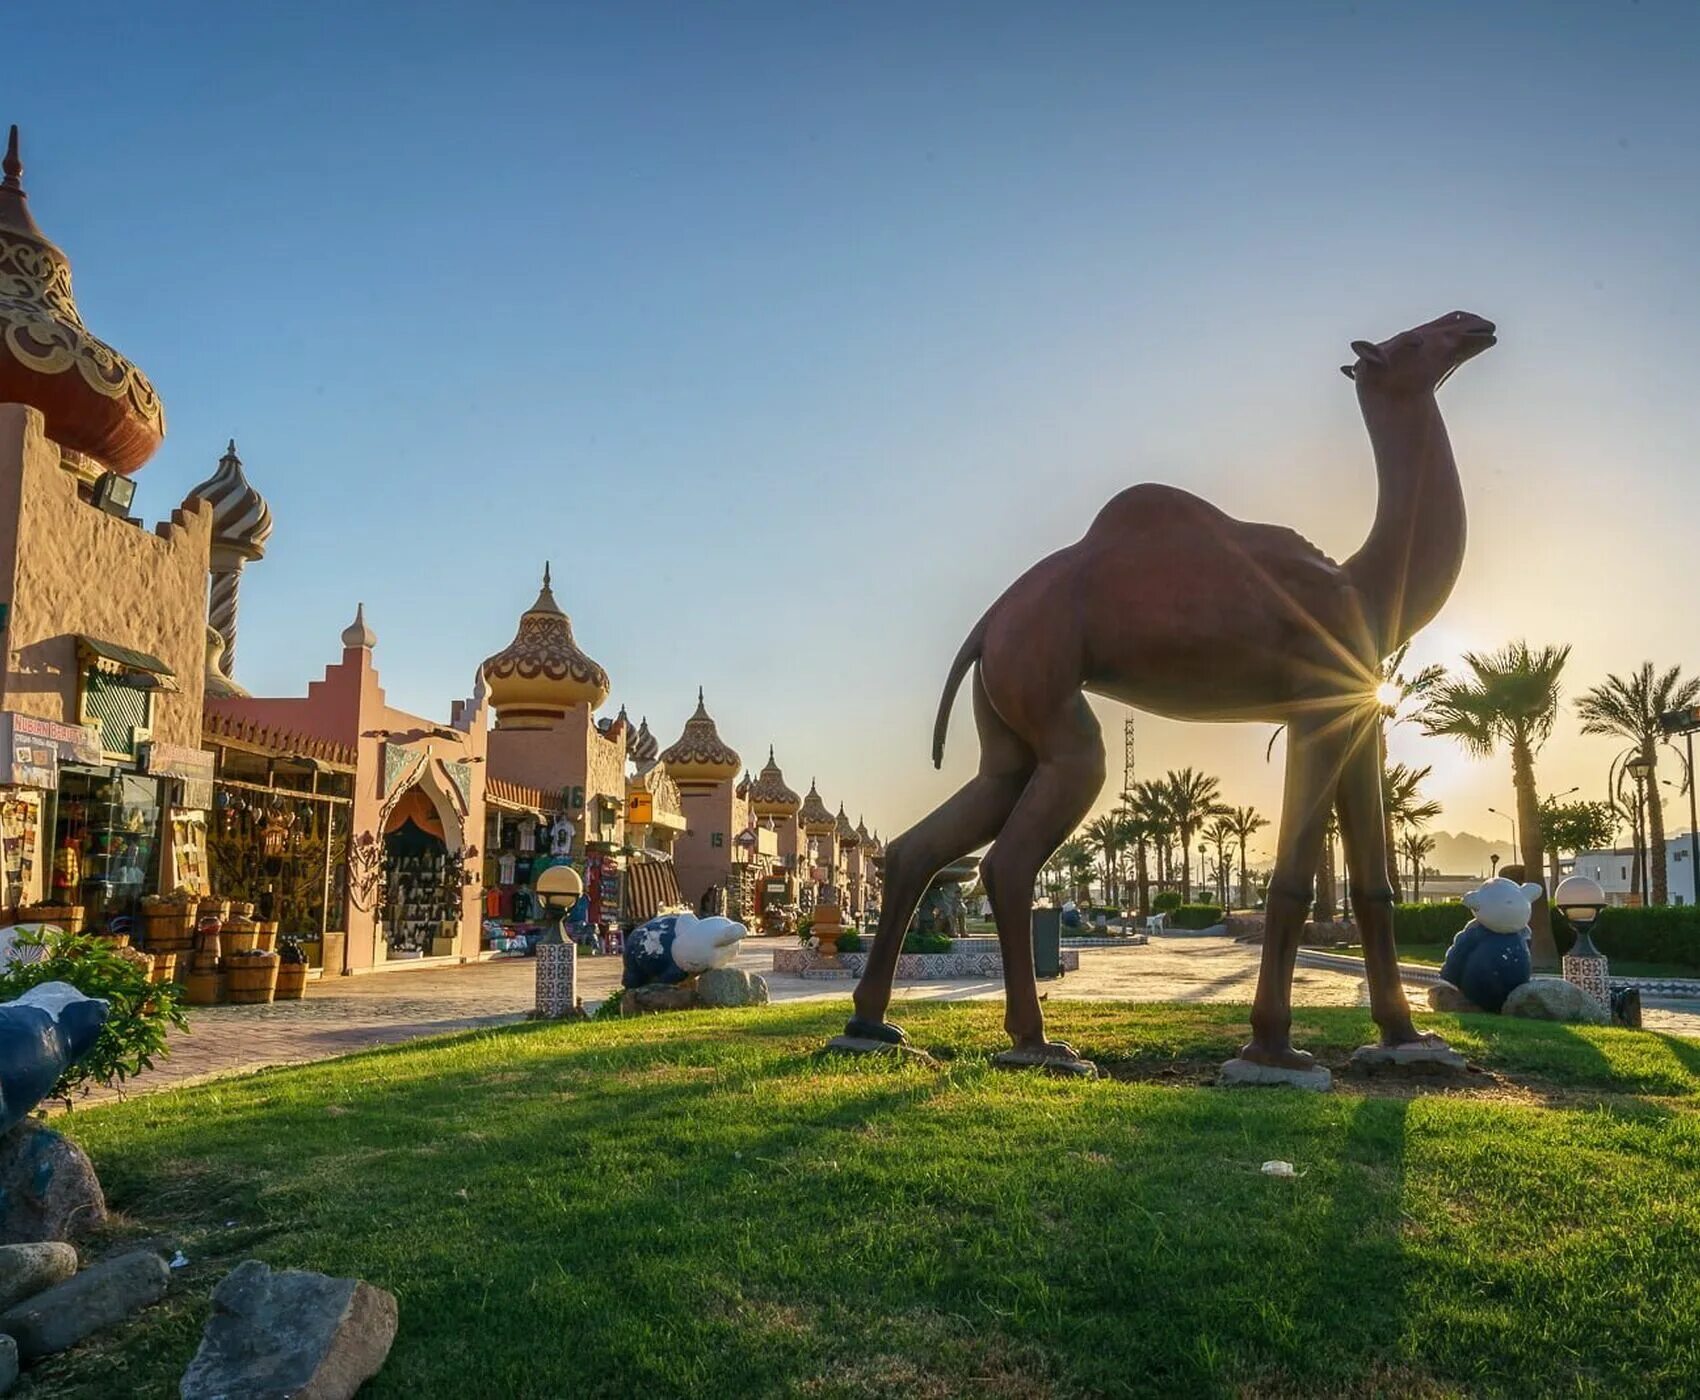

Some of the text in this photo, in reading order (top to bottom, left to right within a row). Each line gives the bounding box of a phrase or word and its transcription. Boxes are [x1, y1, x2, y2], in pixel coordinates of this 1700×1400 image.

[15, 714, 48, 735] NUBIAN
[562, 786, 583, 808] 16
[711, 832, 723, 847] 15
